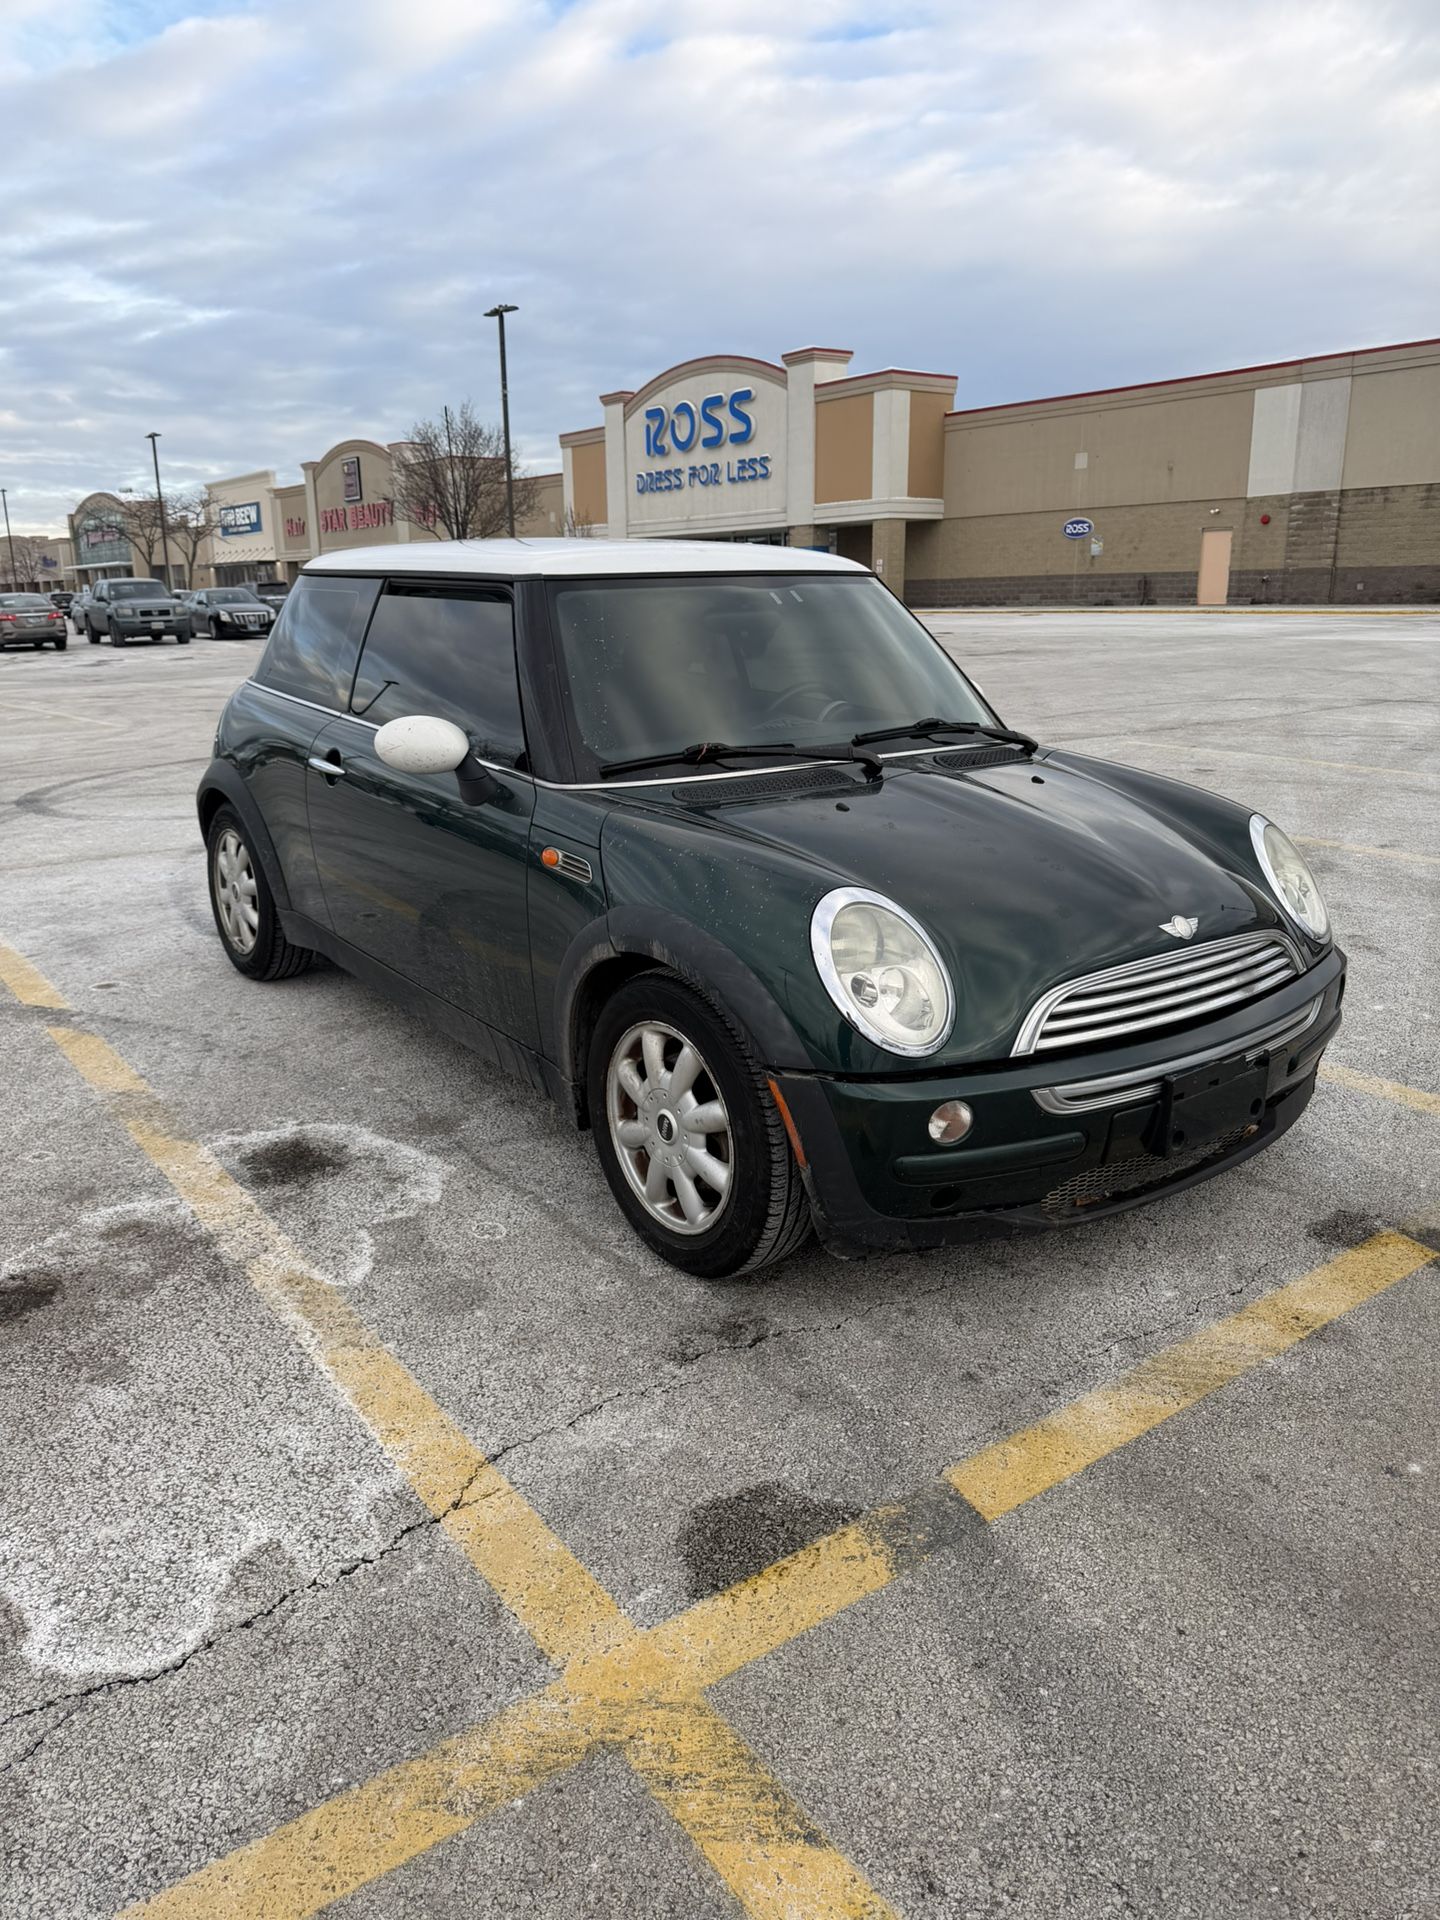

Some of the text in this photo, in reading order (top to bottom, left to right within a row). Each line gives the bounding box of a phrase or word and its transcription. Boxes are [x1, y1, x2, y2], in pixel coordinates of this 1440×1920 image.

[645, 387, 756, 457] ROSS
[636, 454, 771, 494] DRESS FOR LESS
[285, 517, 305, 537] Hair
[320, 507, 348, 533] STAR
[349, 501, 394, 530] BEAUTY
[1065, 523, 1089, 533] ROSS
